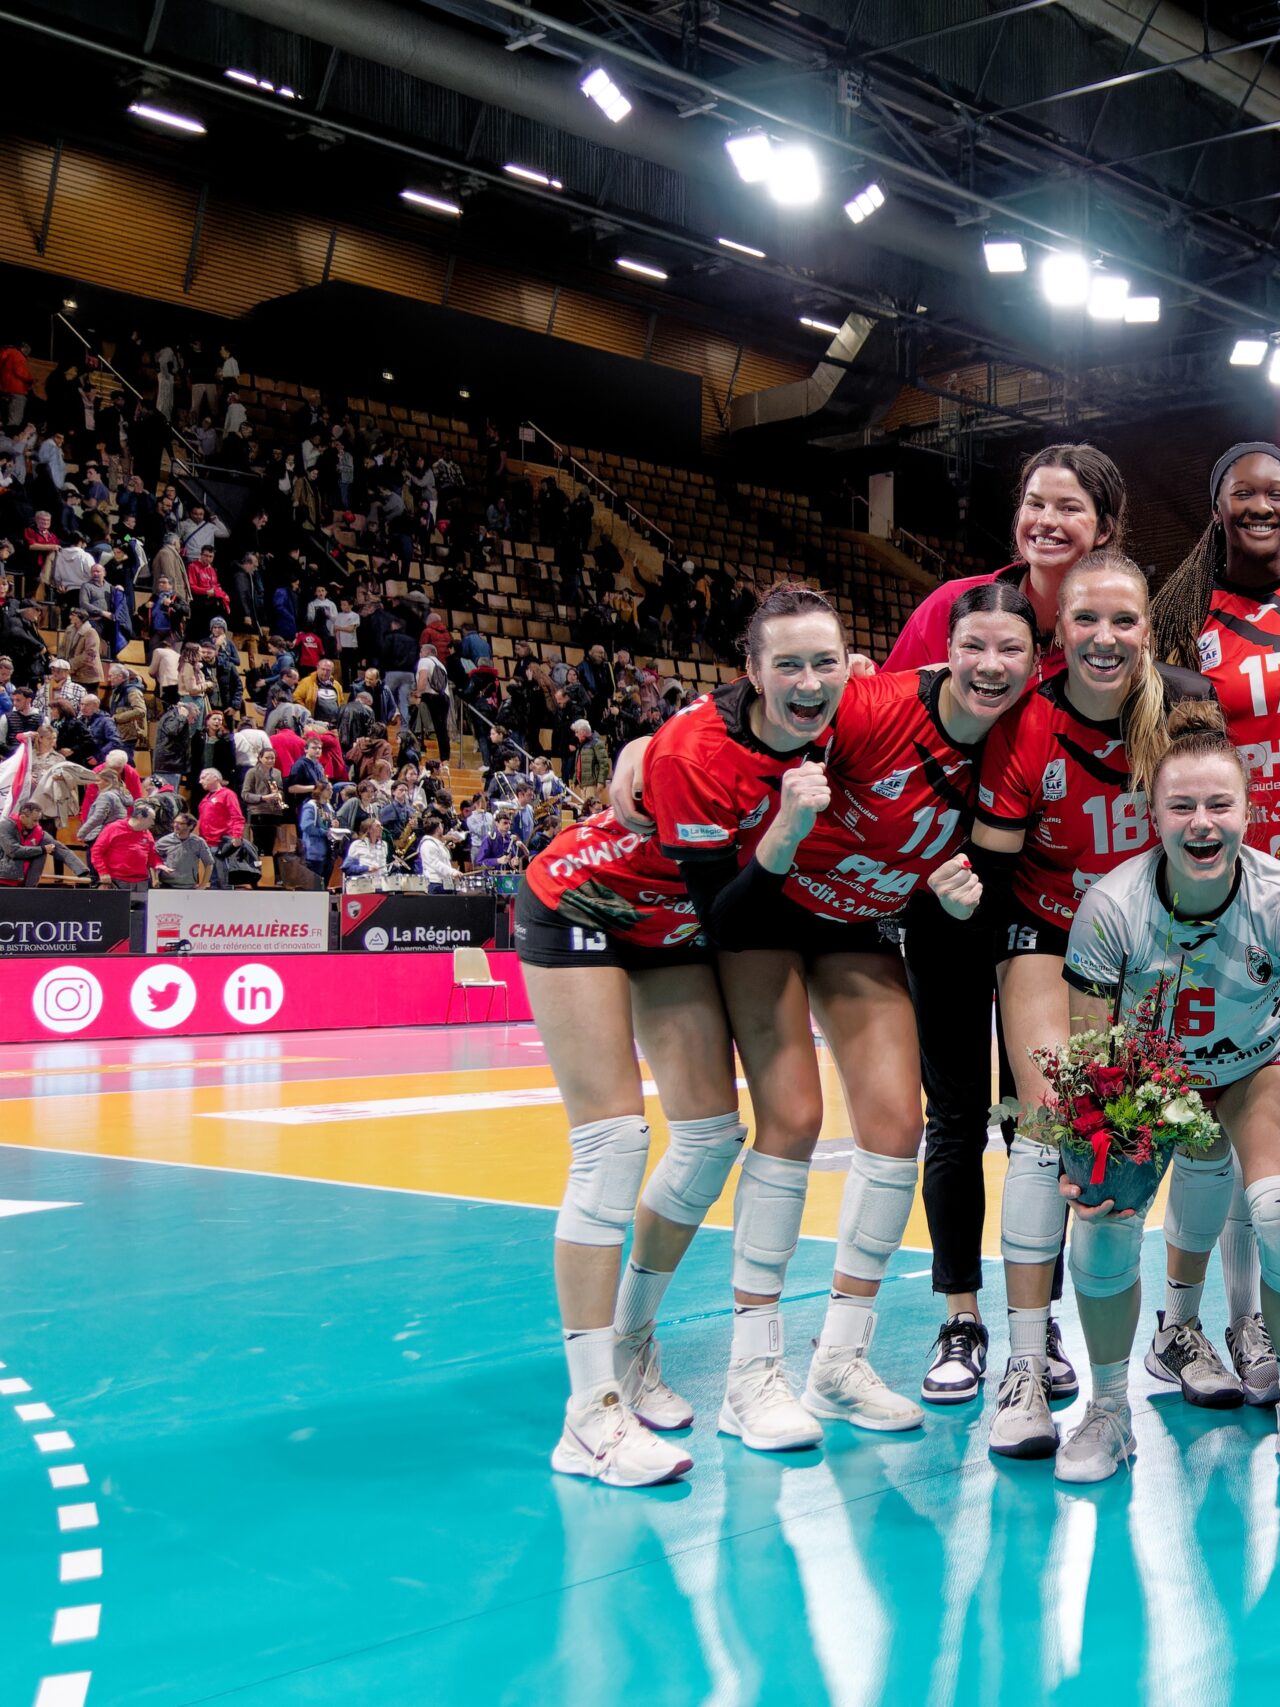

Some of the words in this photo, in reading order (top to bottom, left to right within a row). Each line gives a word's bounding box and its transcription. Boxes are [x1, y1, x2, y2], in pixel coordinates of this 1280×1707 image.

[897, 806, 961, 860] 11
[1082, 791, 1149, 854] 18
[836, 854, 920, 896] PHA
[867, 891, 904, 903] MICHY
[7, 943, 77, 951] BISTRONOMIQUE
[210, 942, 220, 950] de
[223, 941, 261, 950] référence
[274, 941, 320, 950] d'innovation
[393, 926, 411, 941] La
[415, 926, 470, 944] Région
[1007, 923, 1038, 950] 18
[1174, 988, 1215, 1037] 6
